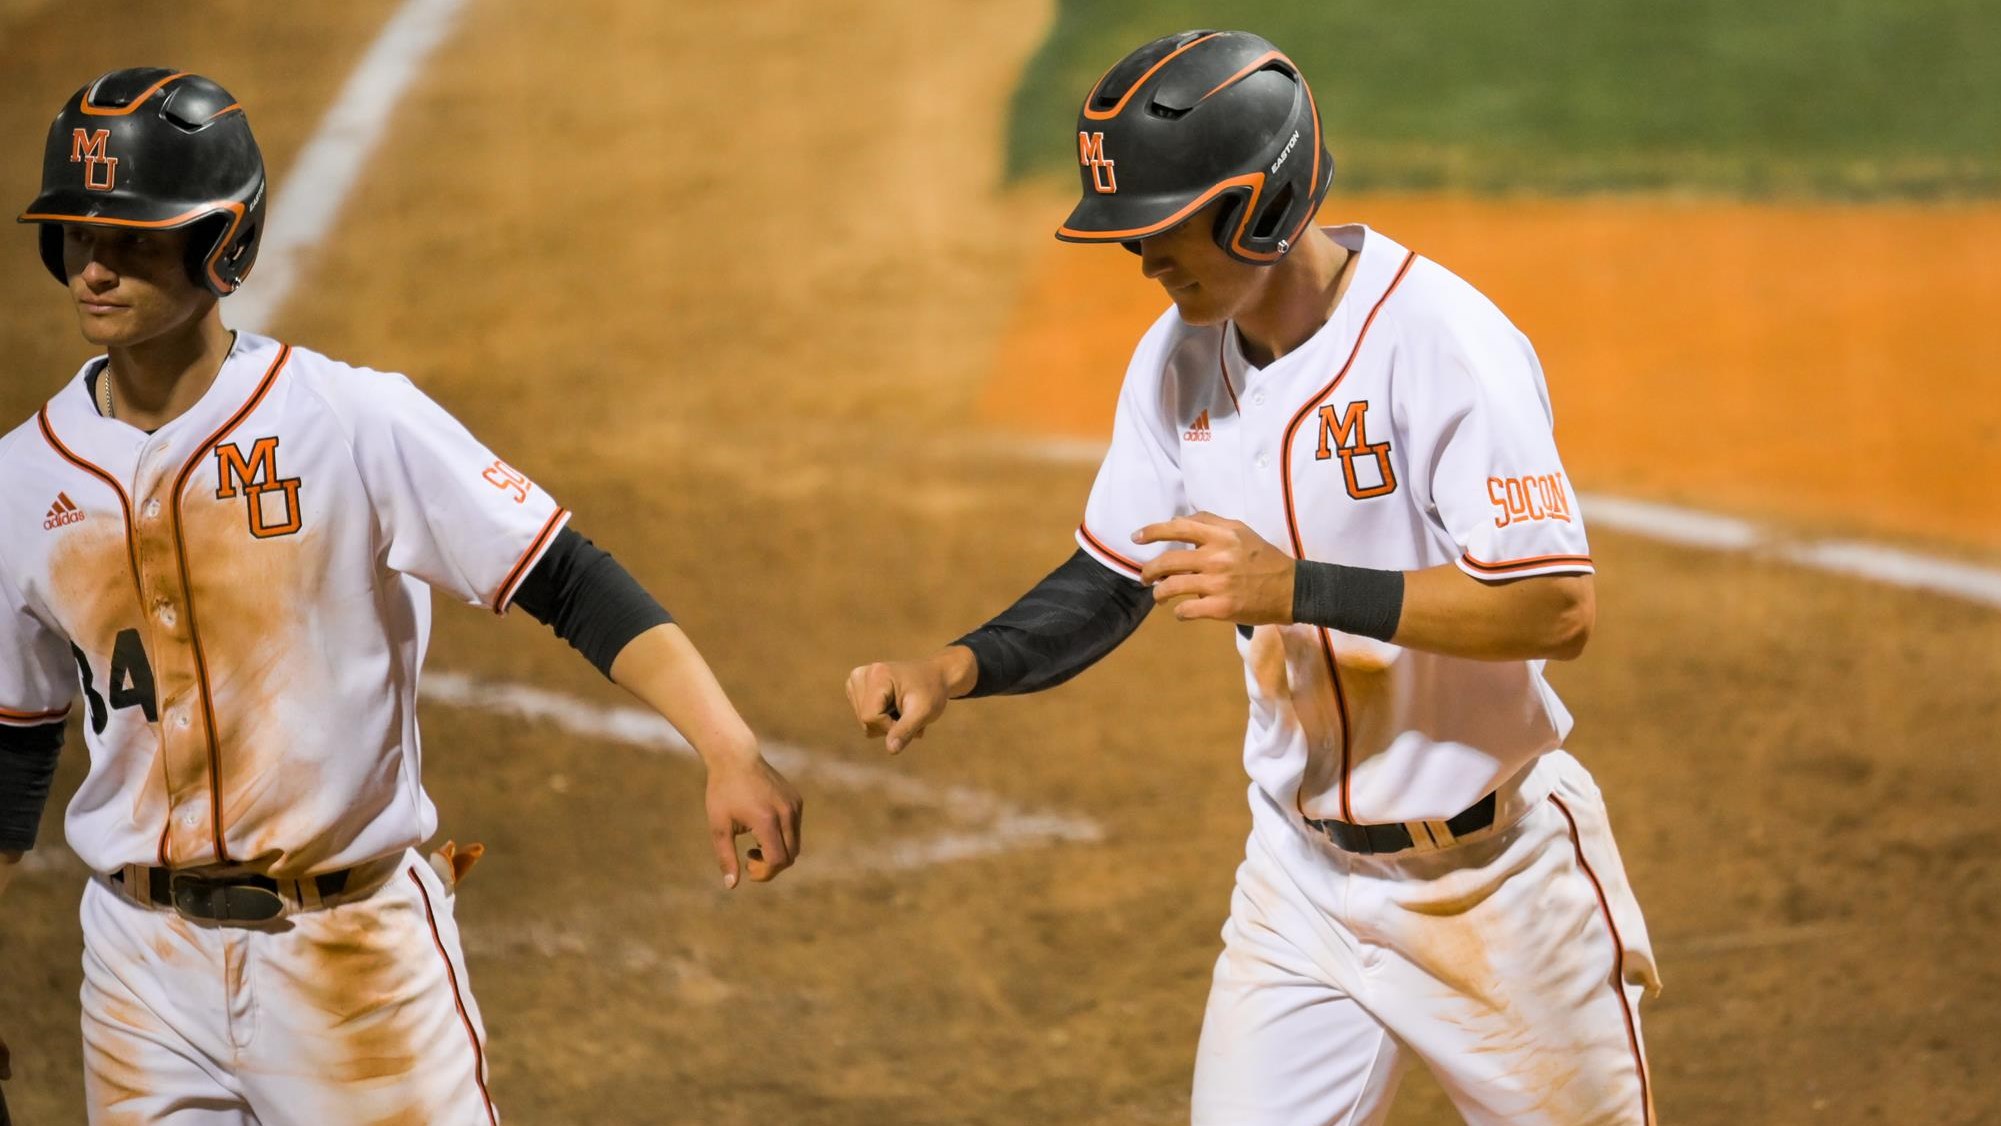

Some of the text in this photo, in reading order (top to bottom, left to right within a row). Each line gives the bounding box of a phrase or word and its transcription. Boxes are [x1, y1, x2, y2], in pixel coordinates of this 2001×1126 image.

[70, 128, 118, 192] MU
[1079, 131, 1117, 193] MU
[1271, 130, 1299, 174] EASTON
[1315, 400, 1398, 500] MU
[214, 436, 302, 539] MU
[43, 510, 85, 530] adidas
